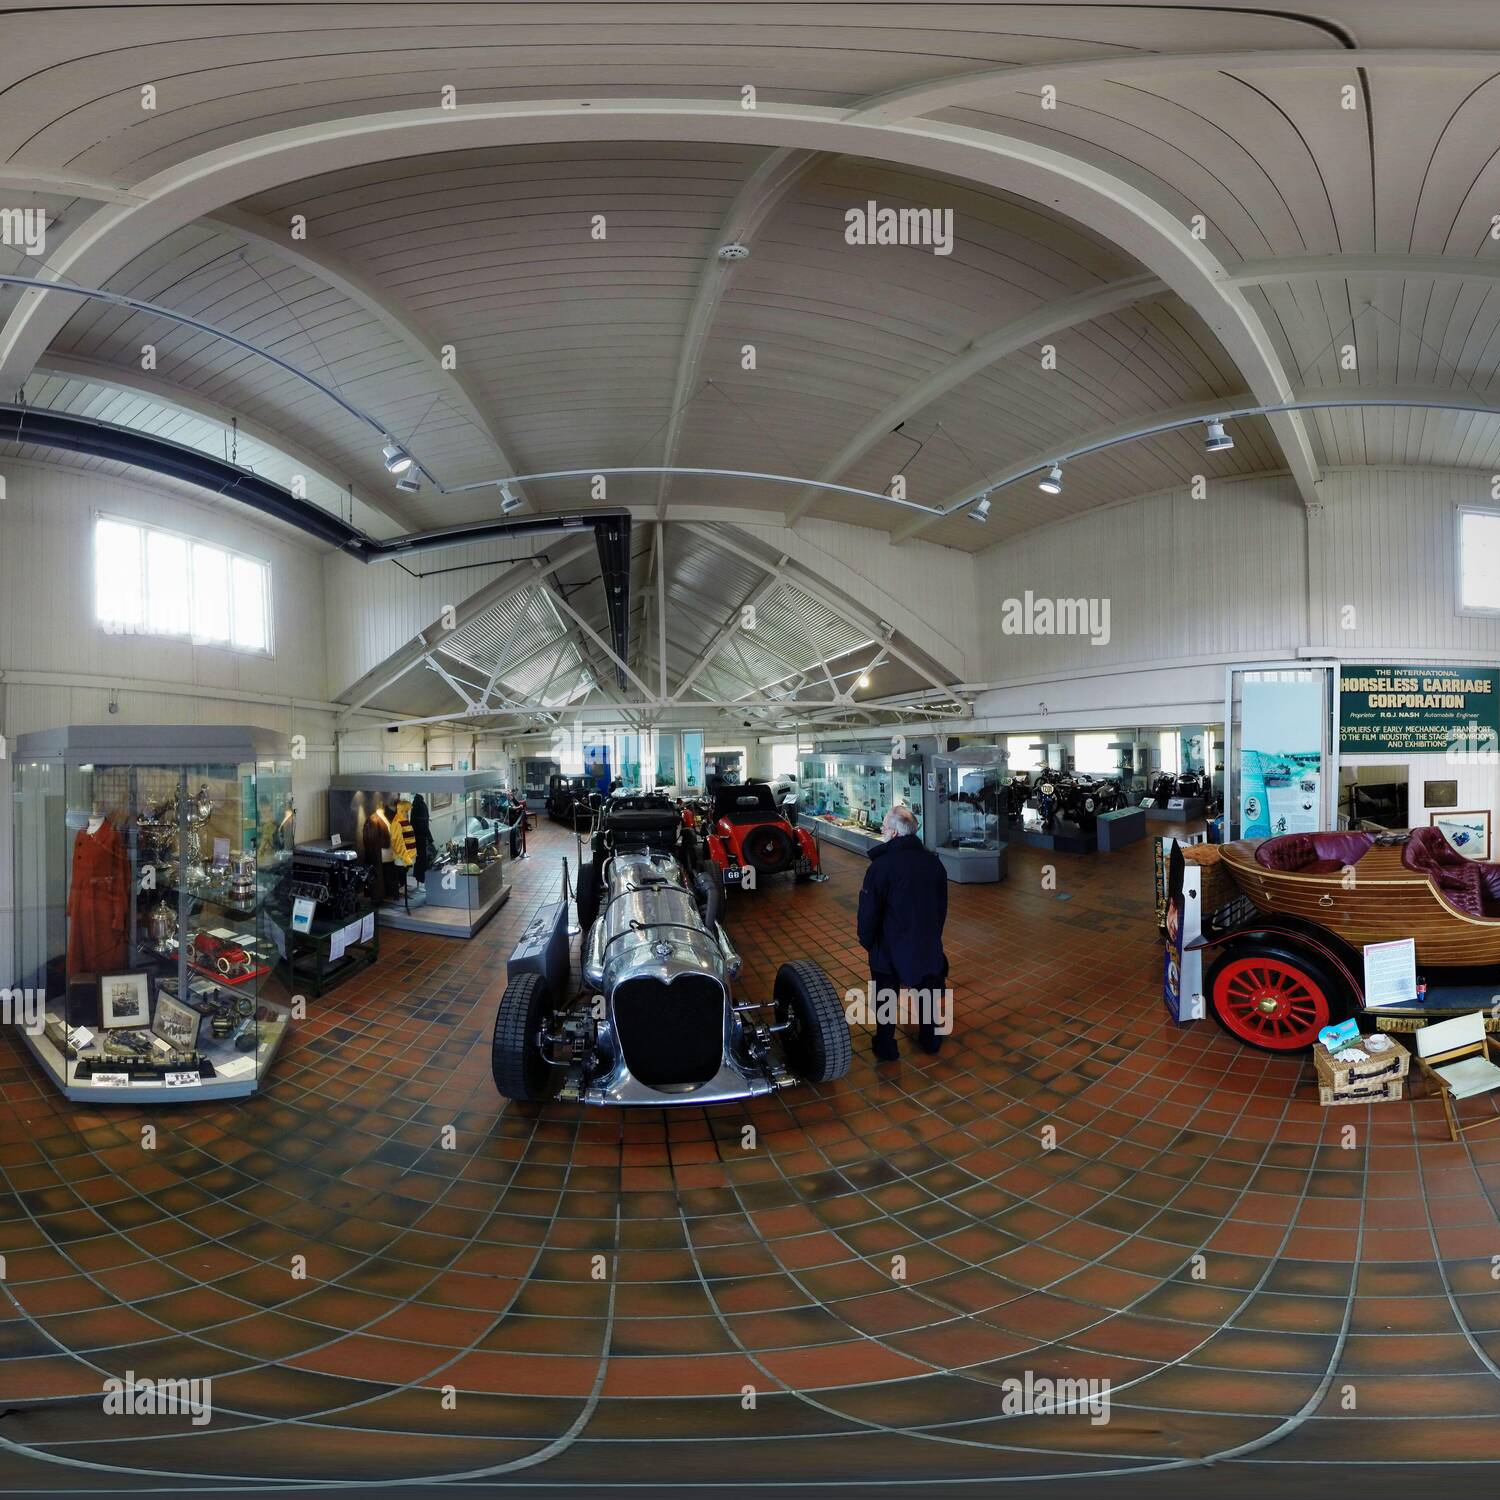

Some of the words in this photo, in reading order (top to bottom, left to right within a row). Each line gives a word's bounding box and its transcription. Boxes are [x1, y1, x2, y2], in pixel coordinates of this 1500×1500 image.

[1394, 669, 1459, 677] INTERNATIONAL
[1340, 677, 1419, 692] HORSELESS
[1423, 679, 1492, 693] CARRIAGE
[1368, 694, 1465, 709] CORPORATION
[1340, 725, 1371, 733] SUPPLIERS
[1372, 725, 1381, 733] OF
[1383, 725, 1403, 733] EARLY
[1405, 725, 1448, 733] MECHANICAL
[1349, 733, 1361, 741] THE
[1362, 733, 1376, 741] FILM
[1415, 733, 1428, 741] THE
[1387, 740, 1403, 748] AND
[1405, 740, 1448, 748] EXHIBITIONS
